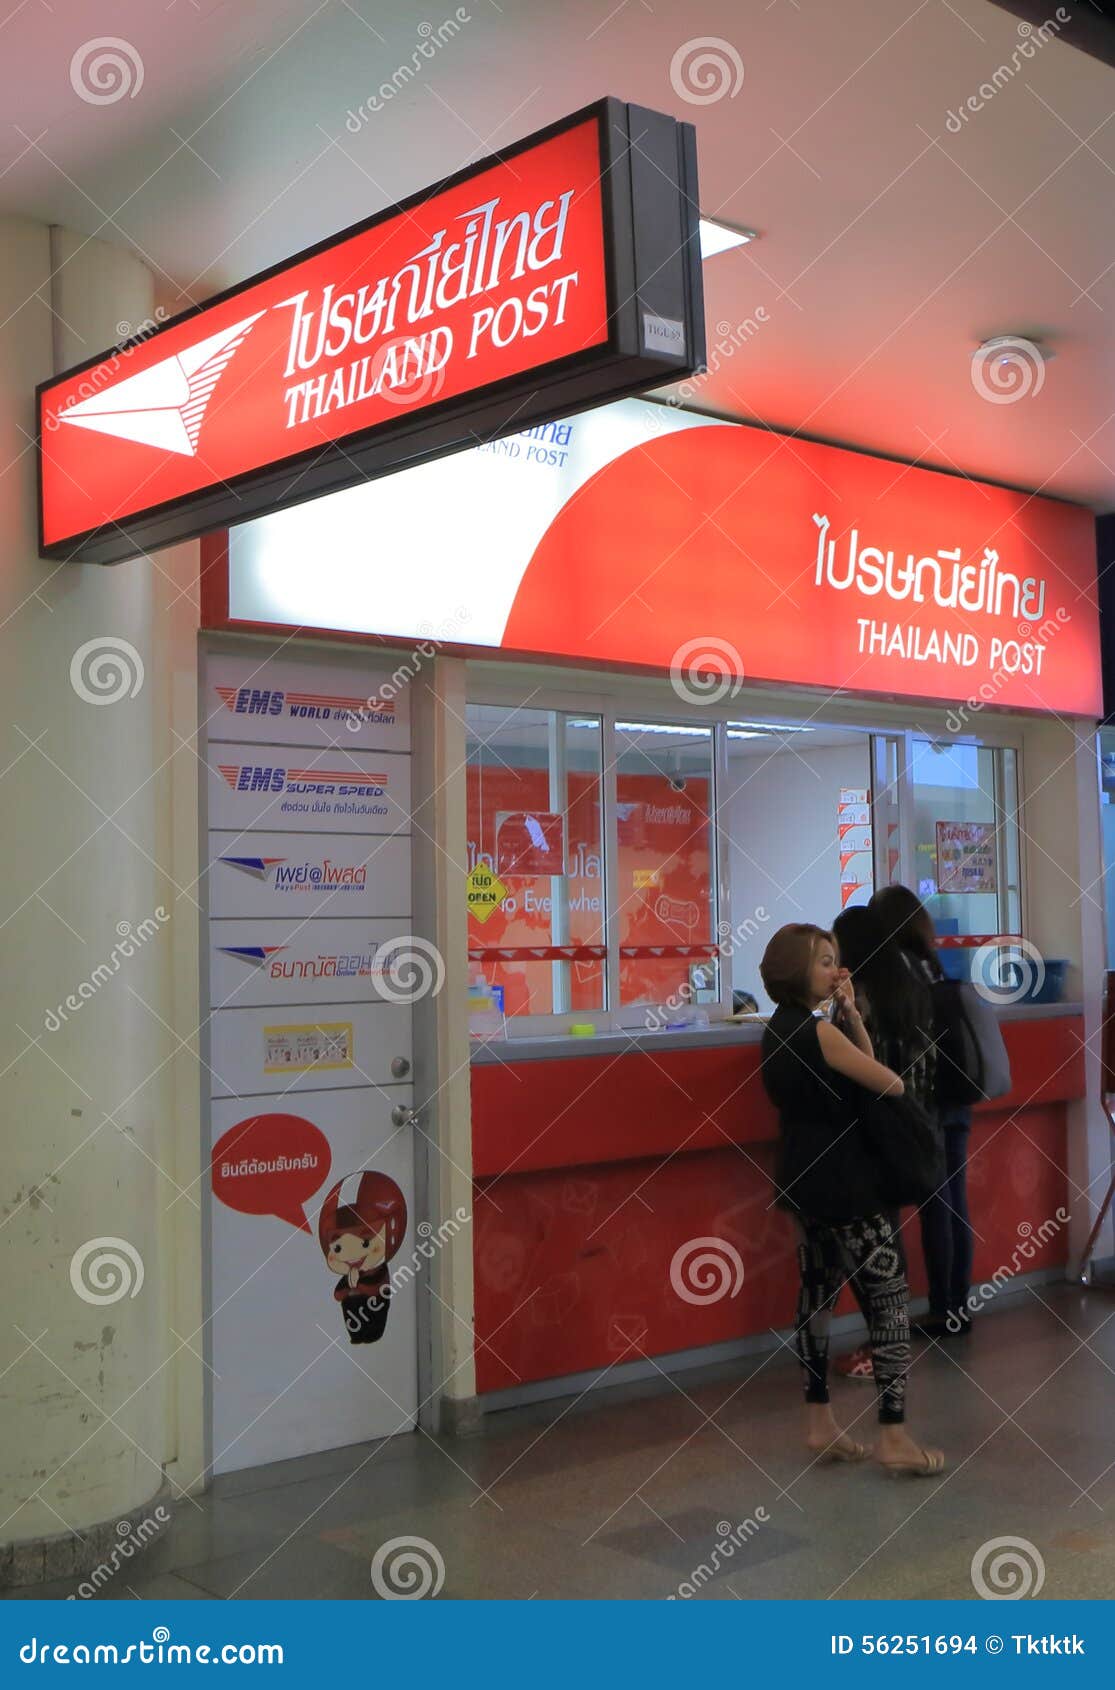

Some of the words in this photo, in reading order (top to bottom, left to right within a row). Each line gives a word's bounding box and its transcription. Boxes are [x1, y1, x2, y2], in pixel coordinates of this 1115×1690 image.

[284, 326, 453, 429] THAILAND
[467, 273, 579, 358] POST
[526, 445, 569, 468] POST
[857, 618, 979, 667] THAILAND
[989, 637, 1047, 676] POST
[235, 688, 284, 716] EMS
[290, 704, 331, 721] WORLD
[237, 766, 286, 793] EMS
[286, 783, 336, 795] SUPER
[338, 785, 384, 797] SPEED
[468, 892, 496, 903] OPEN
[221, 1153, 318, 1178] ยินดีต้อนรับครับ
